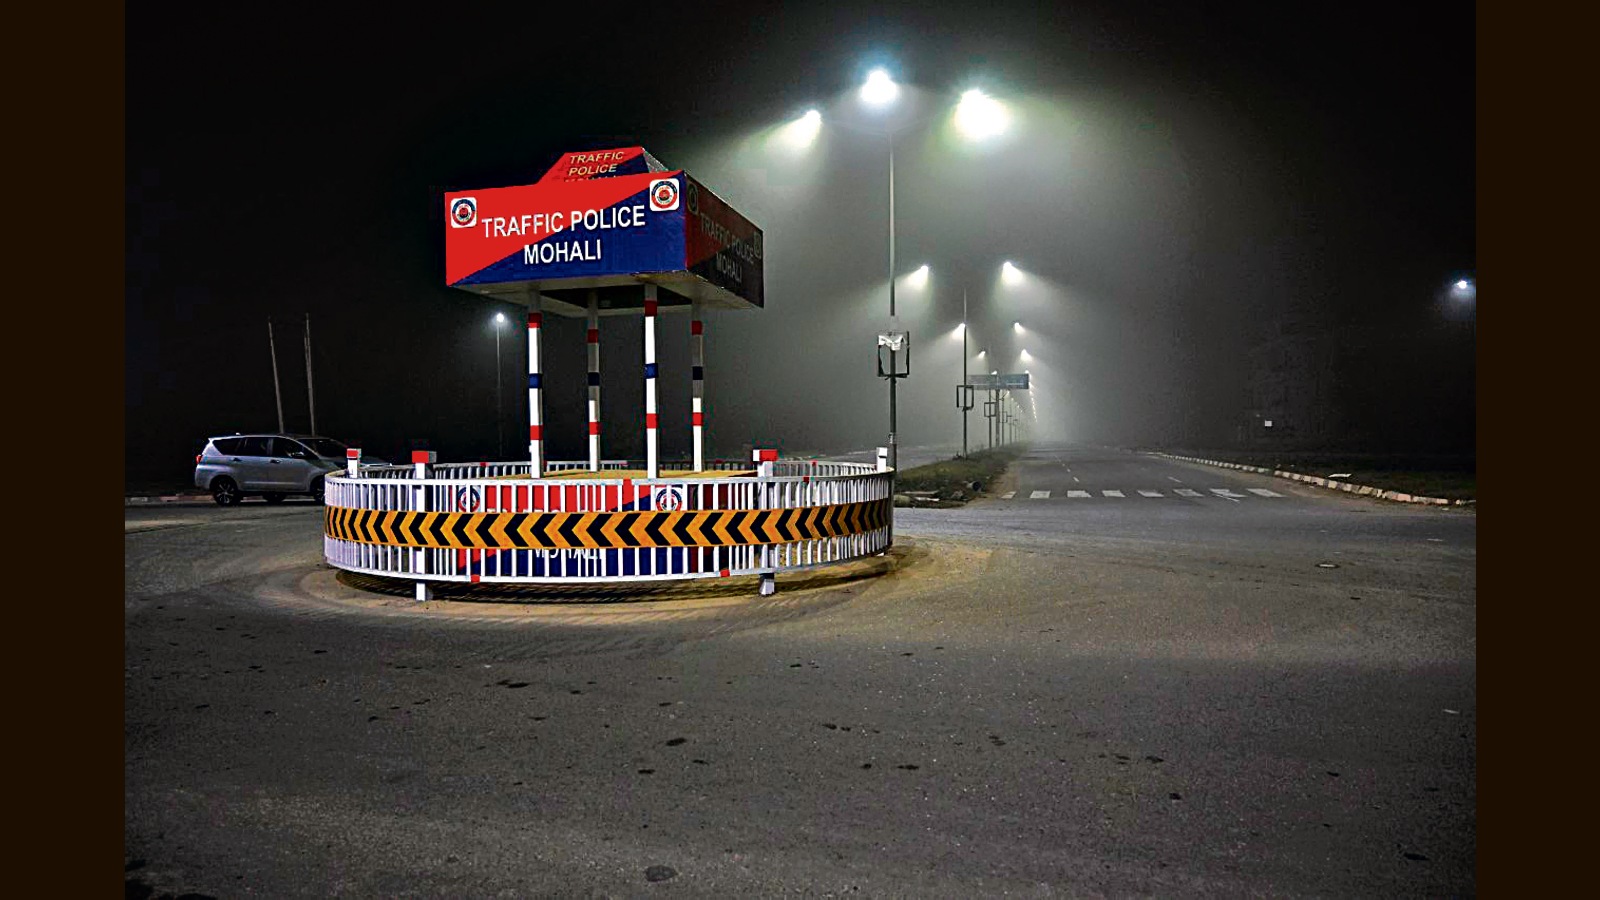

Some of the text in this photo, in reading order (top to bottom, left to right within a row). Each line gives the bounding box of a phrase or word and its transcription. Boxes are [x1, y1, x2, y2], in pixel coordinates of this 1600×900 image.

[570, 151, 625, 164] TRAFFIC
[568, 163, 619, 177] POLICE
[481, 211, 564, 238] TRAFFIC
[570, 204, 646, 231] POLICE
[523, 239, 602, 265] MOHALI
